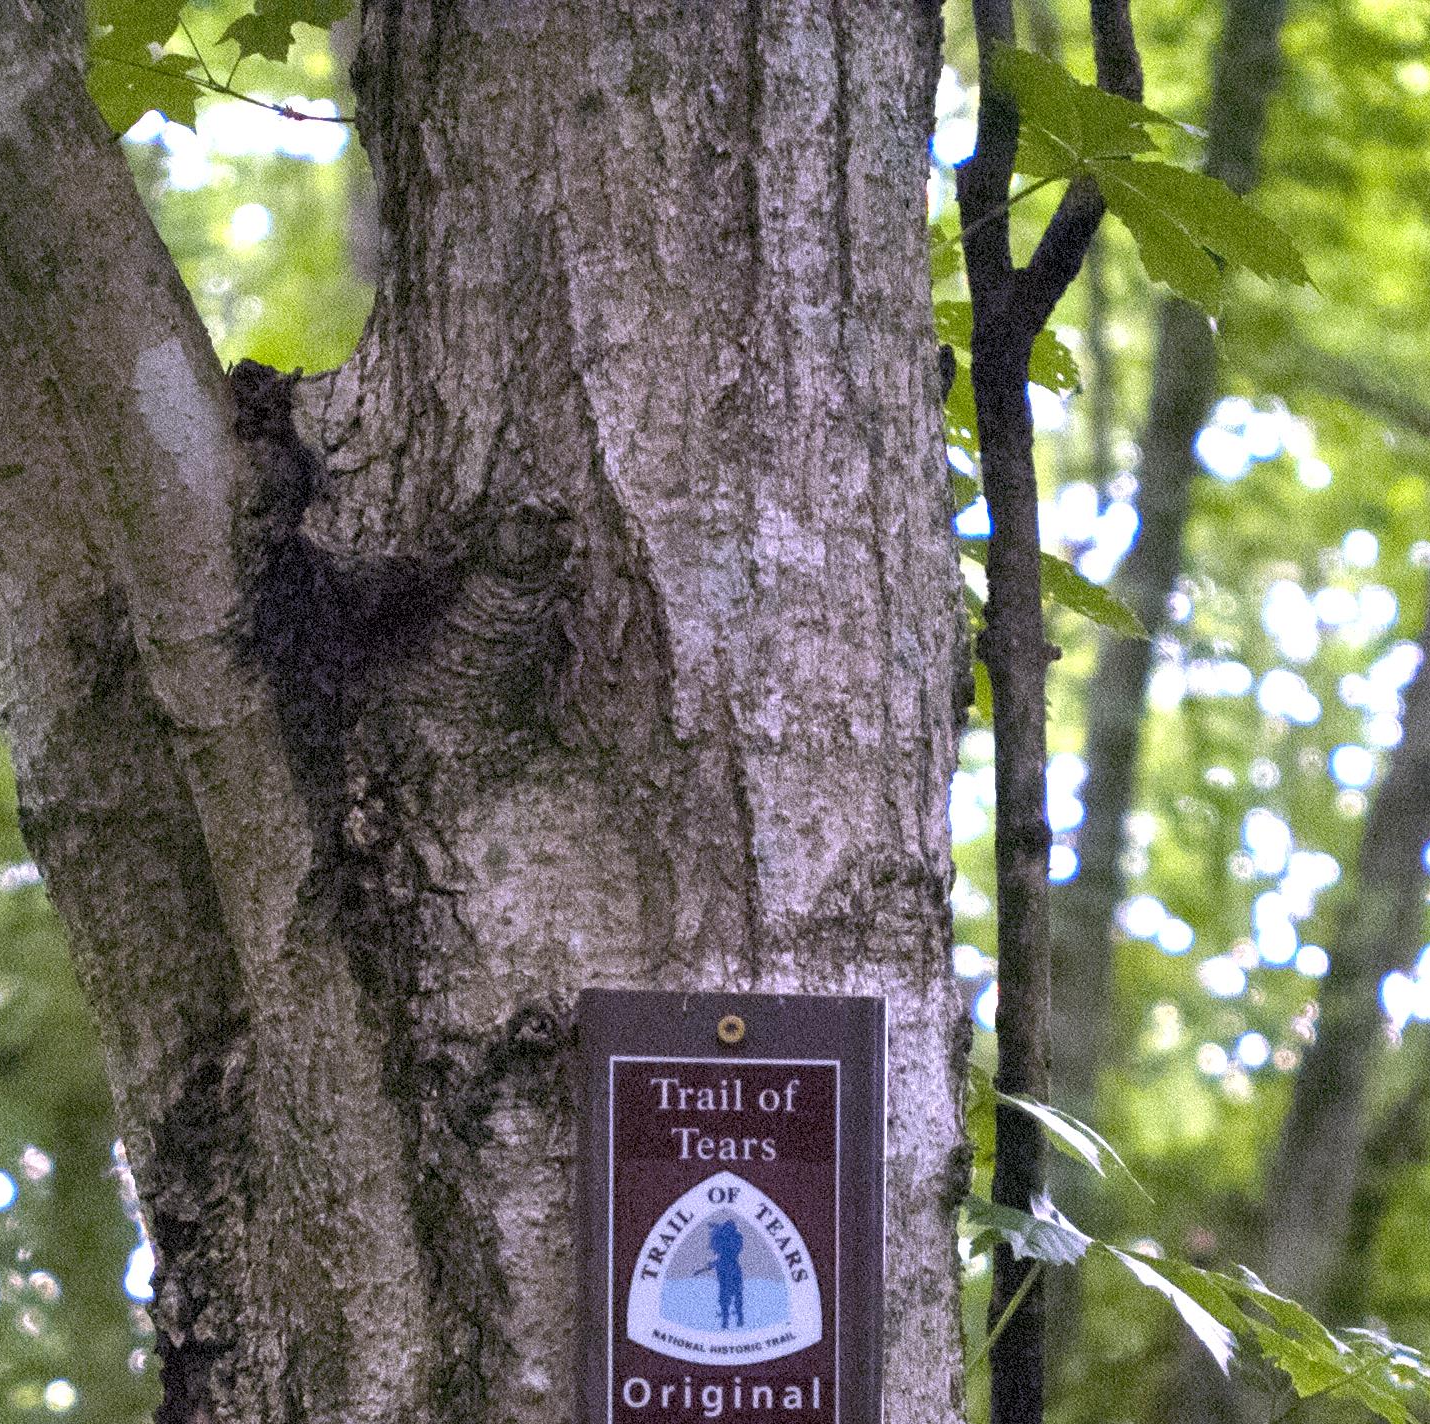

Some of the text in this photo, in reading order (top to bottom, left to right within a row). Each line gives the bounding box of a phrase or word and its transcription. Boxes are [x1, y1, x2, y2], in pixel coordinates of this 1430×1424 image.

[650, 1078, 800, 1112] Trail of
[671, 1127, 777, 1161] Tears
[641, 1186, 809, 1284] TRAIL OF TEARS
[651, 1328, 797, 1355] NATIONAL HISTORIC TRAIL
[623, 1376, 821, 1418] Original
